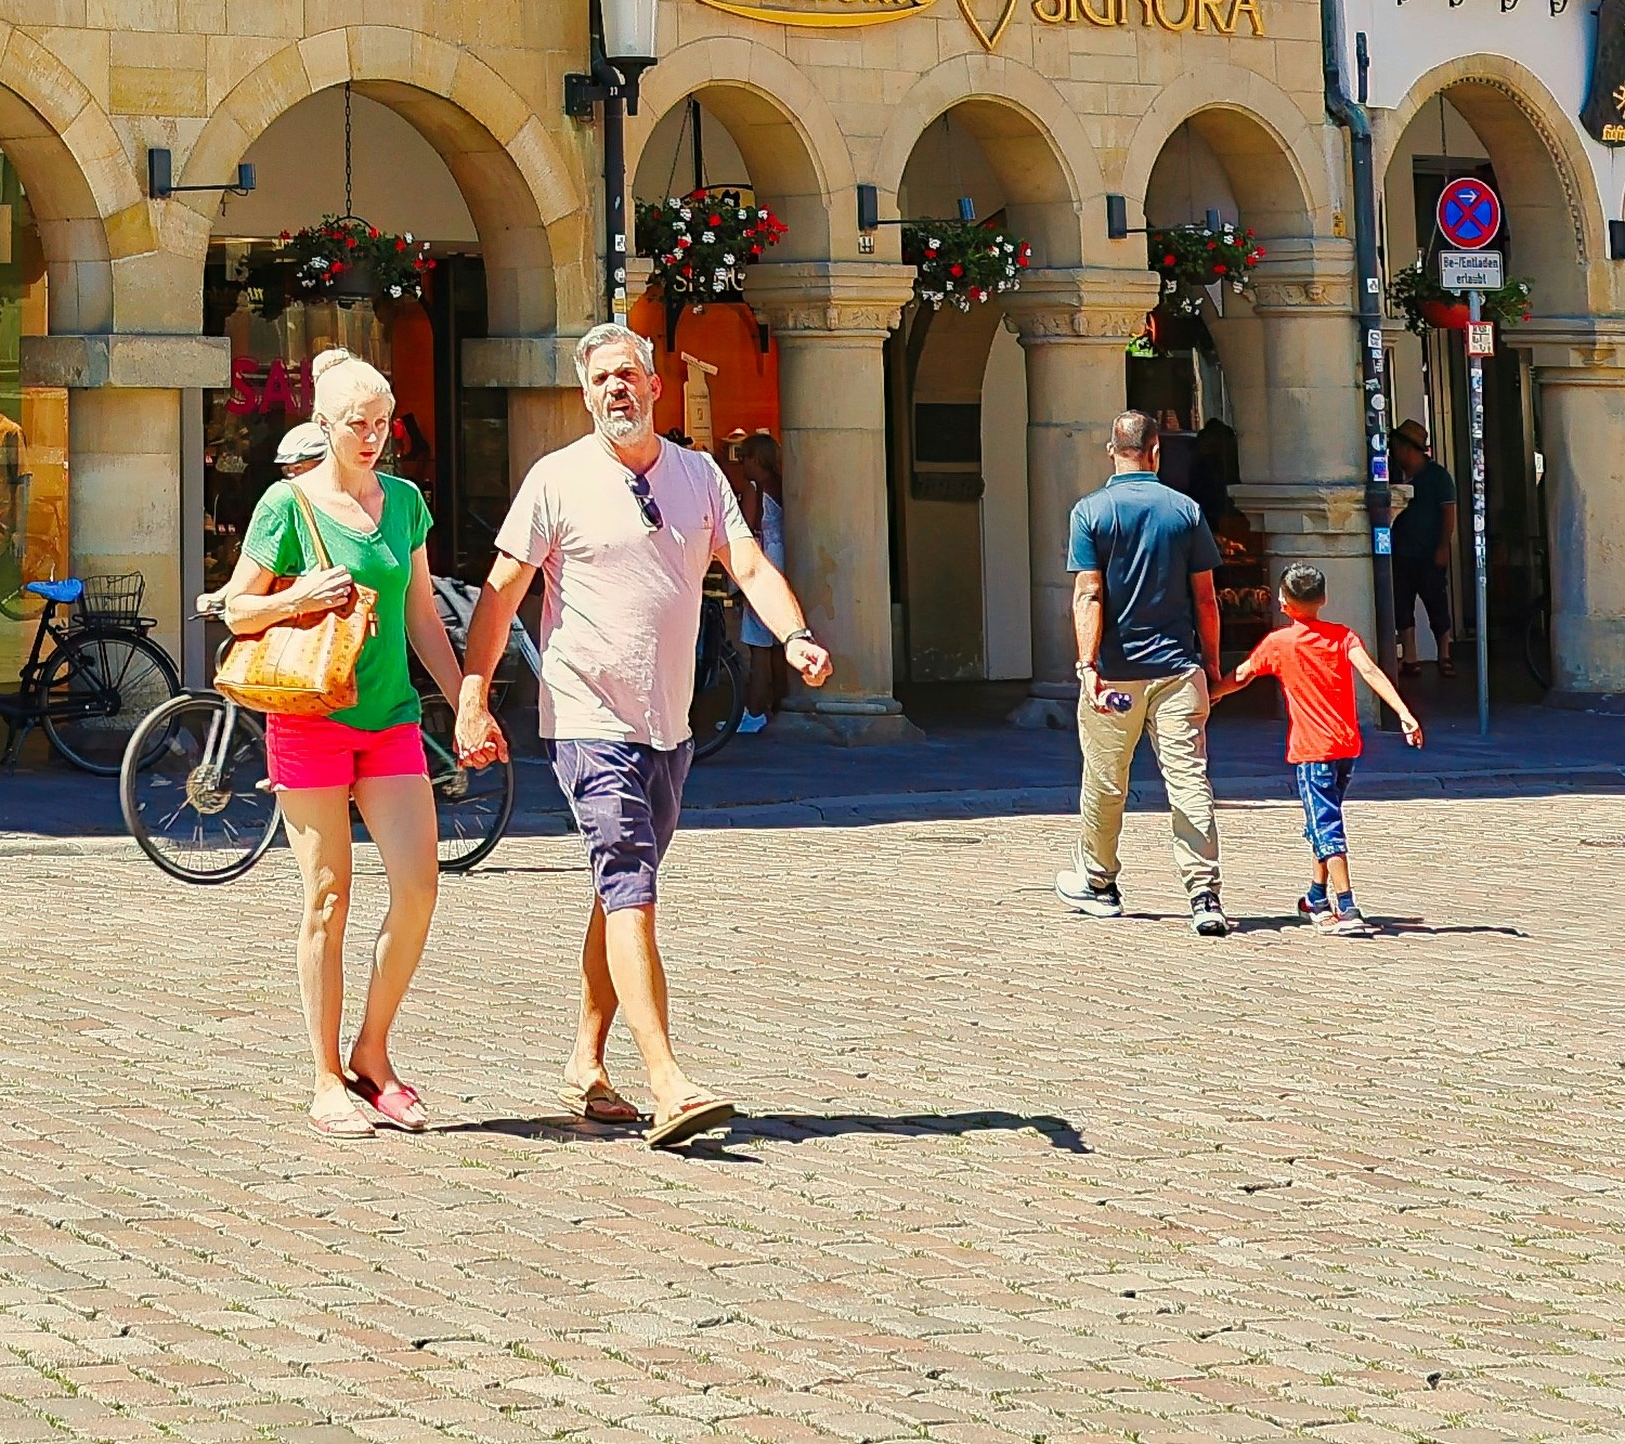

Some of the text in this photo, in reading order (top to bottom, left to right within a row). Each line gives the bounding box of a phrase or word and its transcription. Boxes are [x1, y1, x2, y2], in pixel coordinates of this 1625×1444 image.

[1443, 256, 1499, 269] Be-/Entladen
[1456, 272, 1487, 285] erlaubt
[224, 356, 313, 415] SAL
